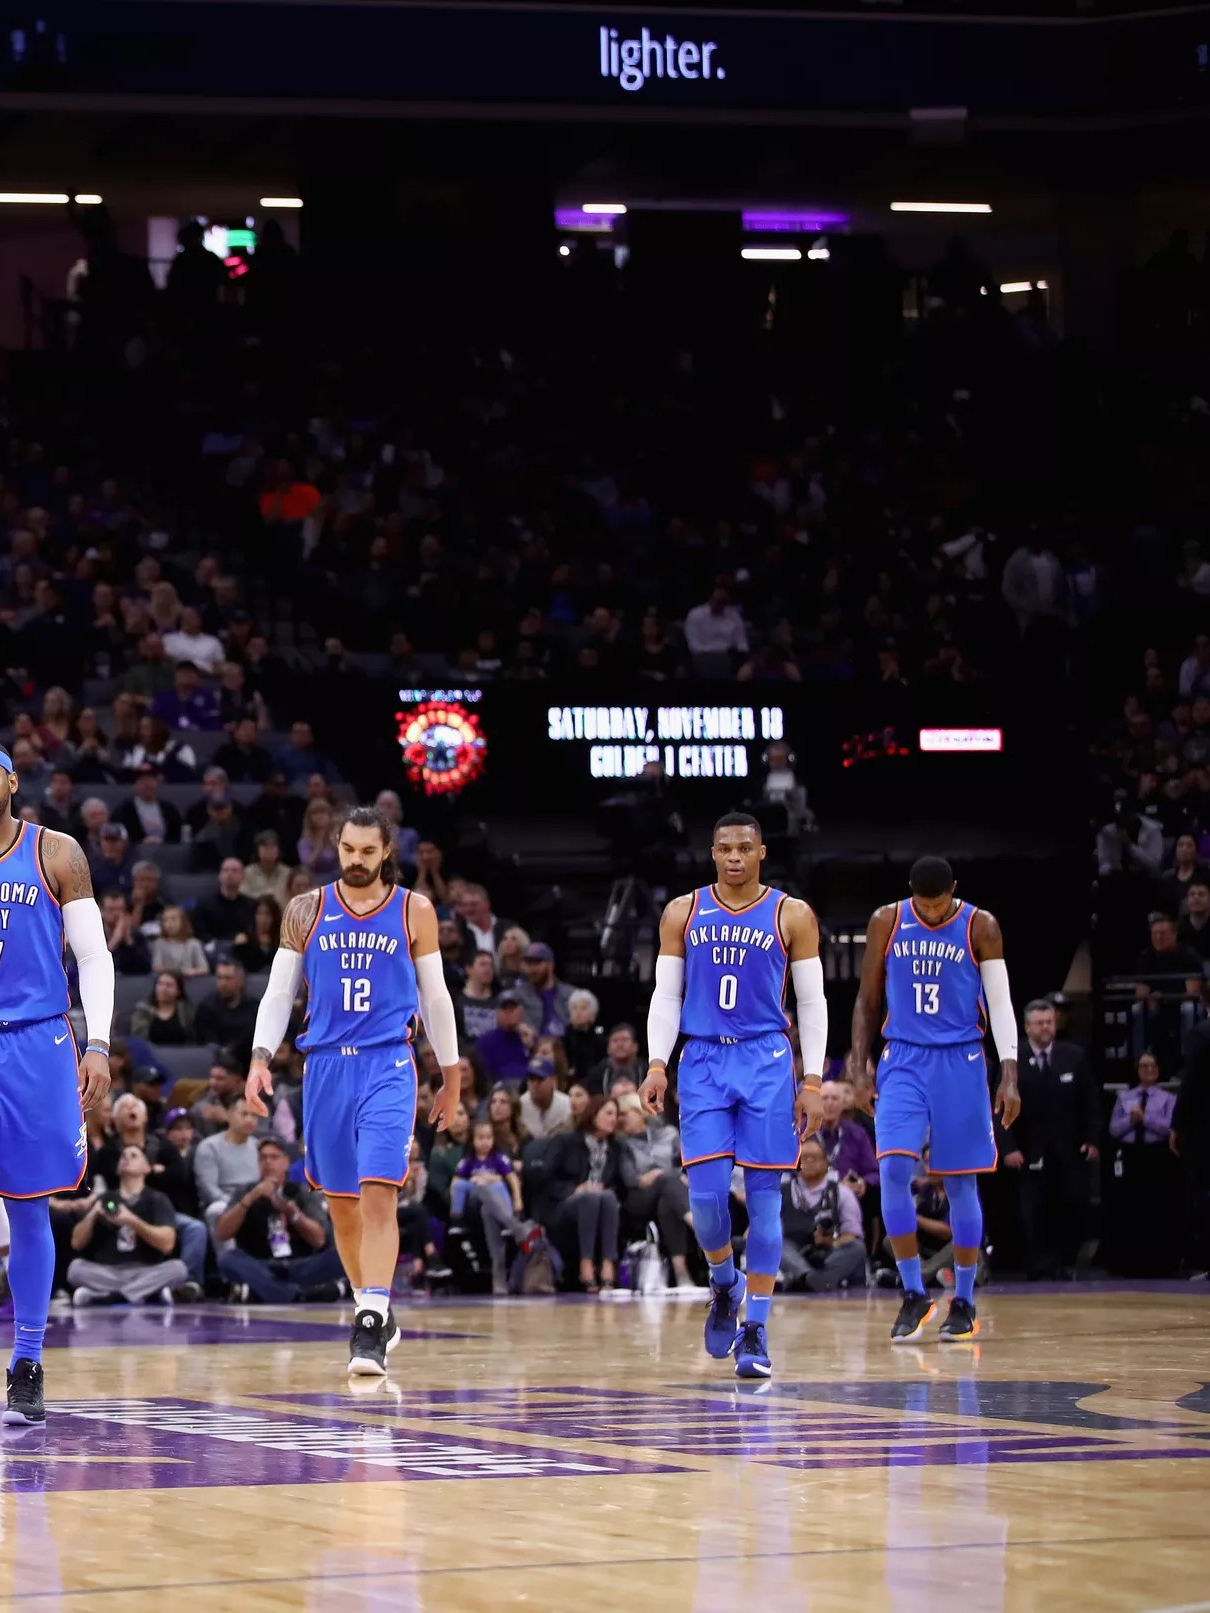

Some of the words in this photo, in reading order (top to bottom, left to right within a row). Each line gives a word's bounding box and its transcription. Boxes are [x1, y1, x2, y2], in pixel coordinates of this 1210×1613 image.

[599, 25, 726, 91] lighter.
[548, 706, 655, 744] SATURDAY,
[657, 706, 755, 740] NOVEMBER
[665, 745, 675, 777] 1
[679, 745, 748, 778] CENTER
[318, 931, 399, 955] OKLAHOMA
[690, 924, 775, 951] OKLAHOMA
[893, 940, 966, 963] OKLAHOMA
[341, 953, 373, 970] CITY
[712, 947, 747, 966] CITY
[912, 959, 942, 976] CITY
[340, 977, 371, 1012] 12
[718, 974, 738, 1010] 0
[912, 982, 940, 1015] 13
[42, 1400, 619, 1475] SACRAMENTO
